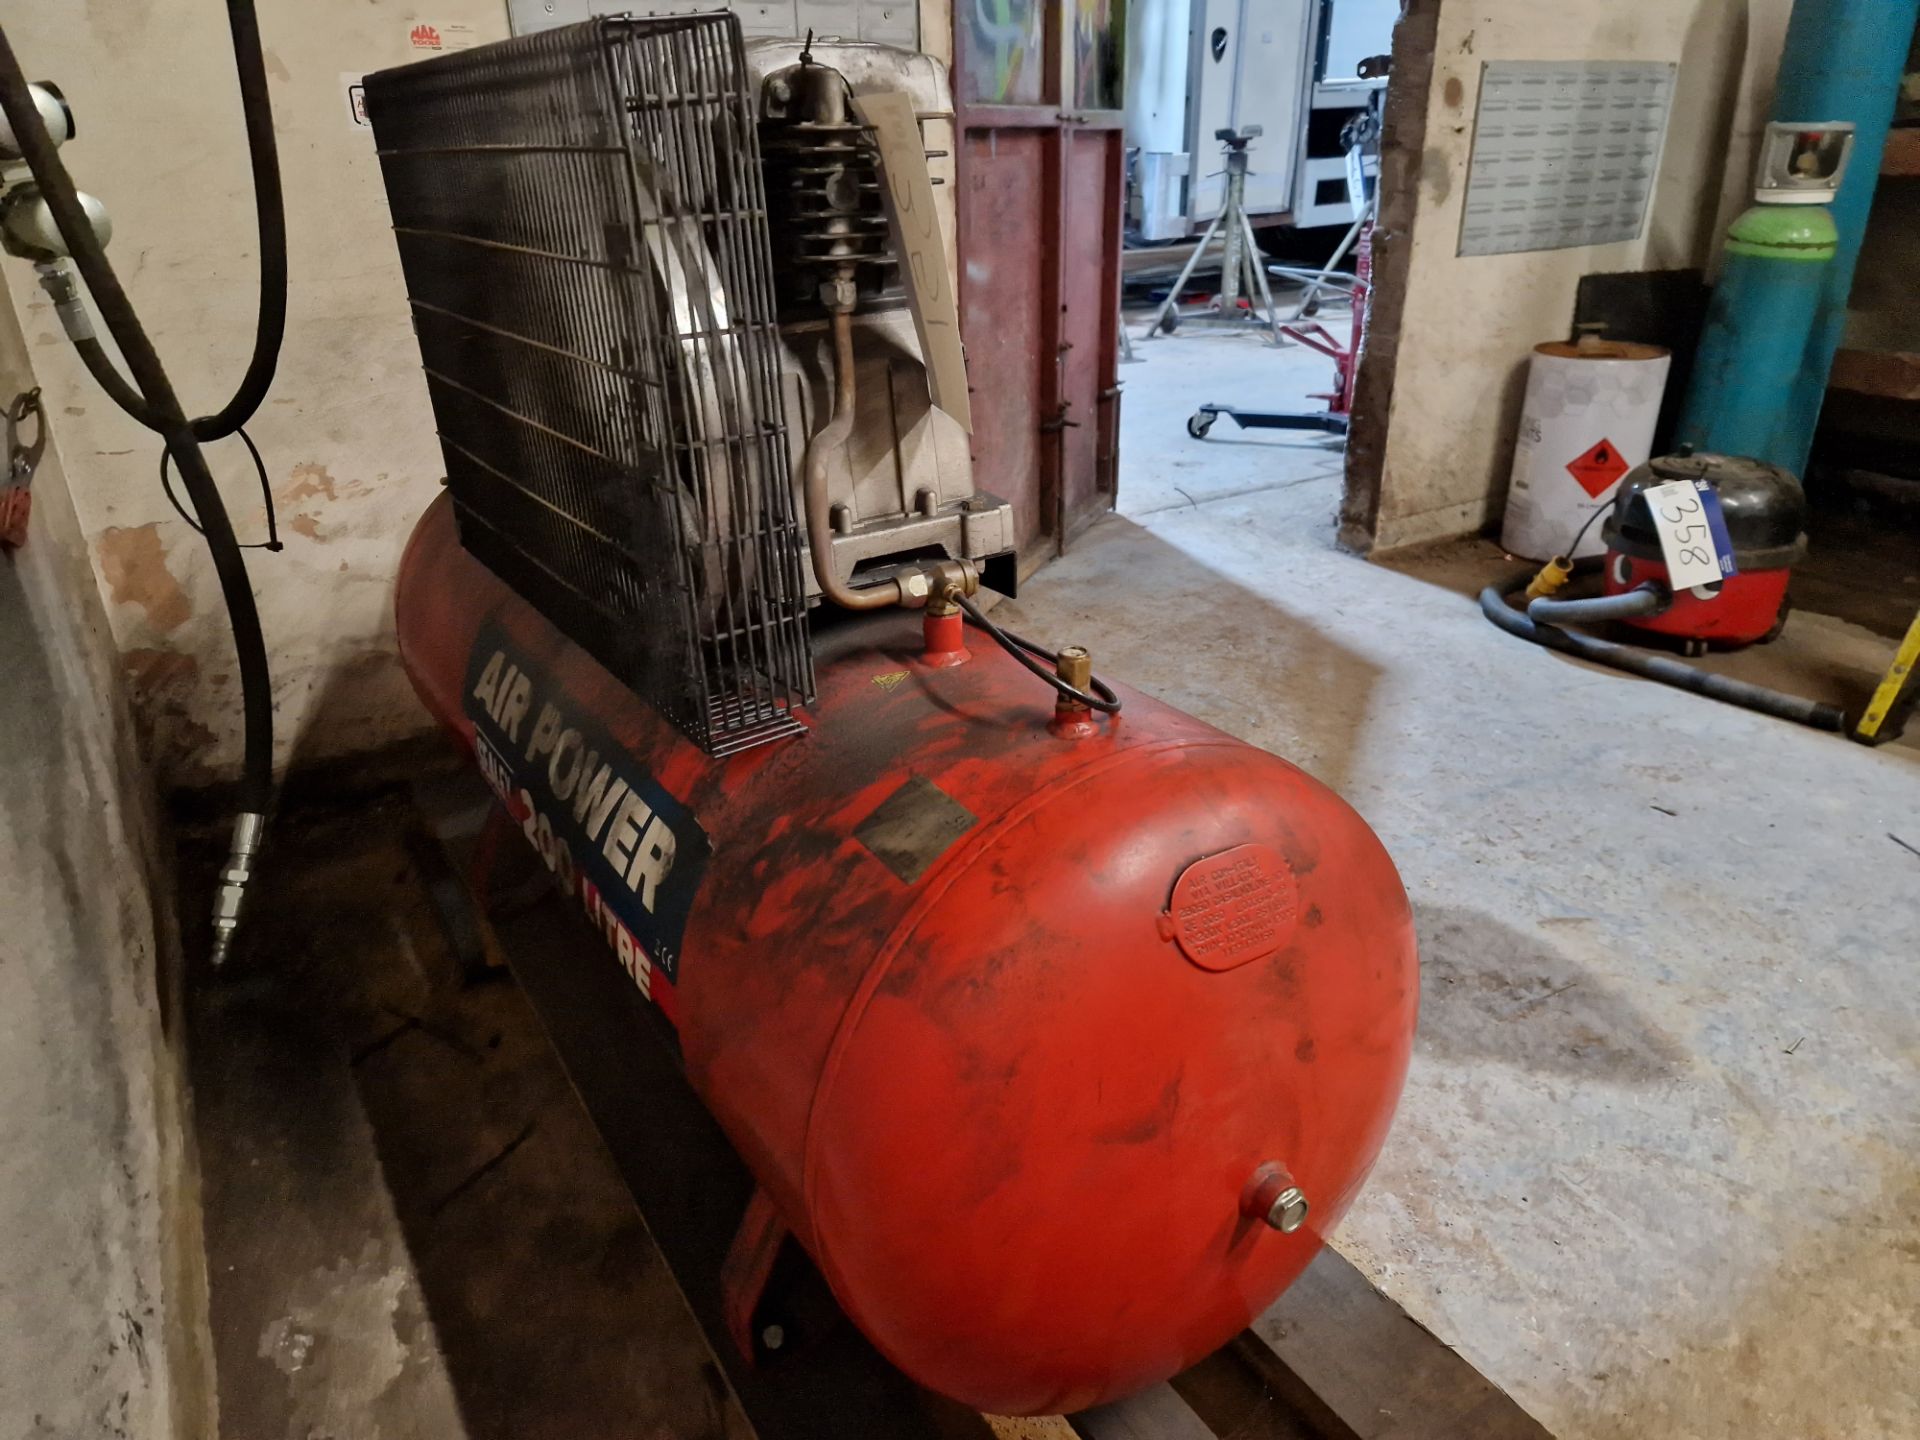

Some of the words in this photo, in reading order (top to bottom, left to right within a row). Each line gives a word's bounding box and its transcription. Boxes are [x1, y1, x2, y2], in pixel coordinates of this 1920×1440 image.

[411, 25, 440, 40] MAC
[1661, 498, 1710, 566] 358
[473, 651, 532, 744] AIR
[524, 701, 677, 915] POWER
[582, 874, 652, 1002] LITRE
